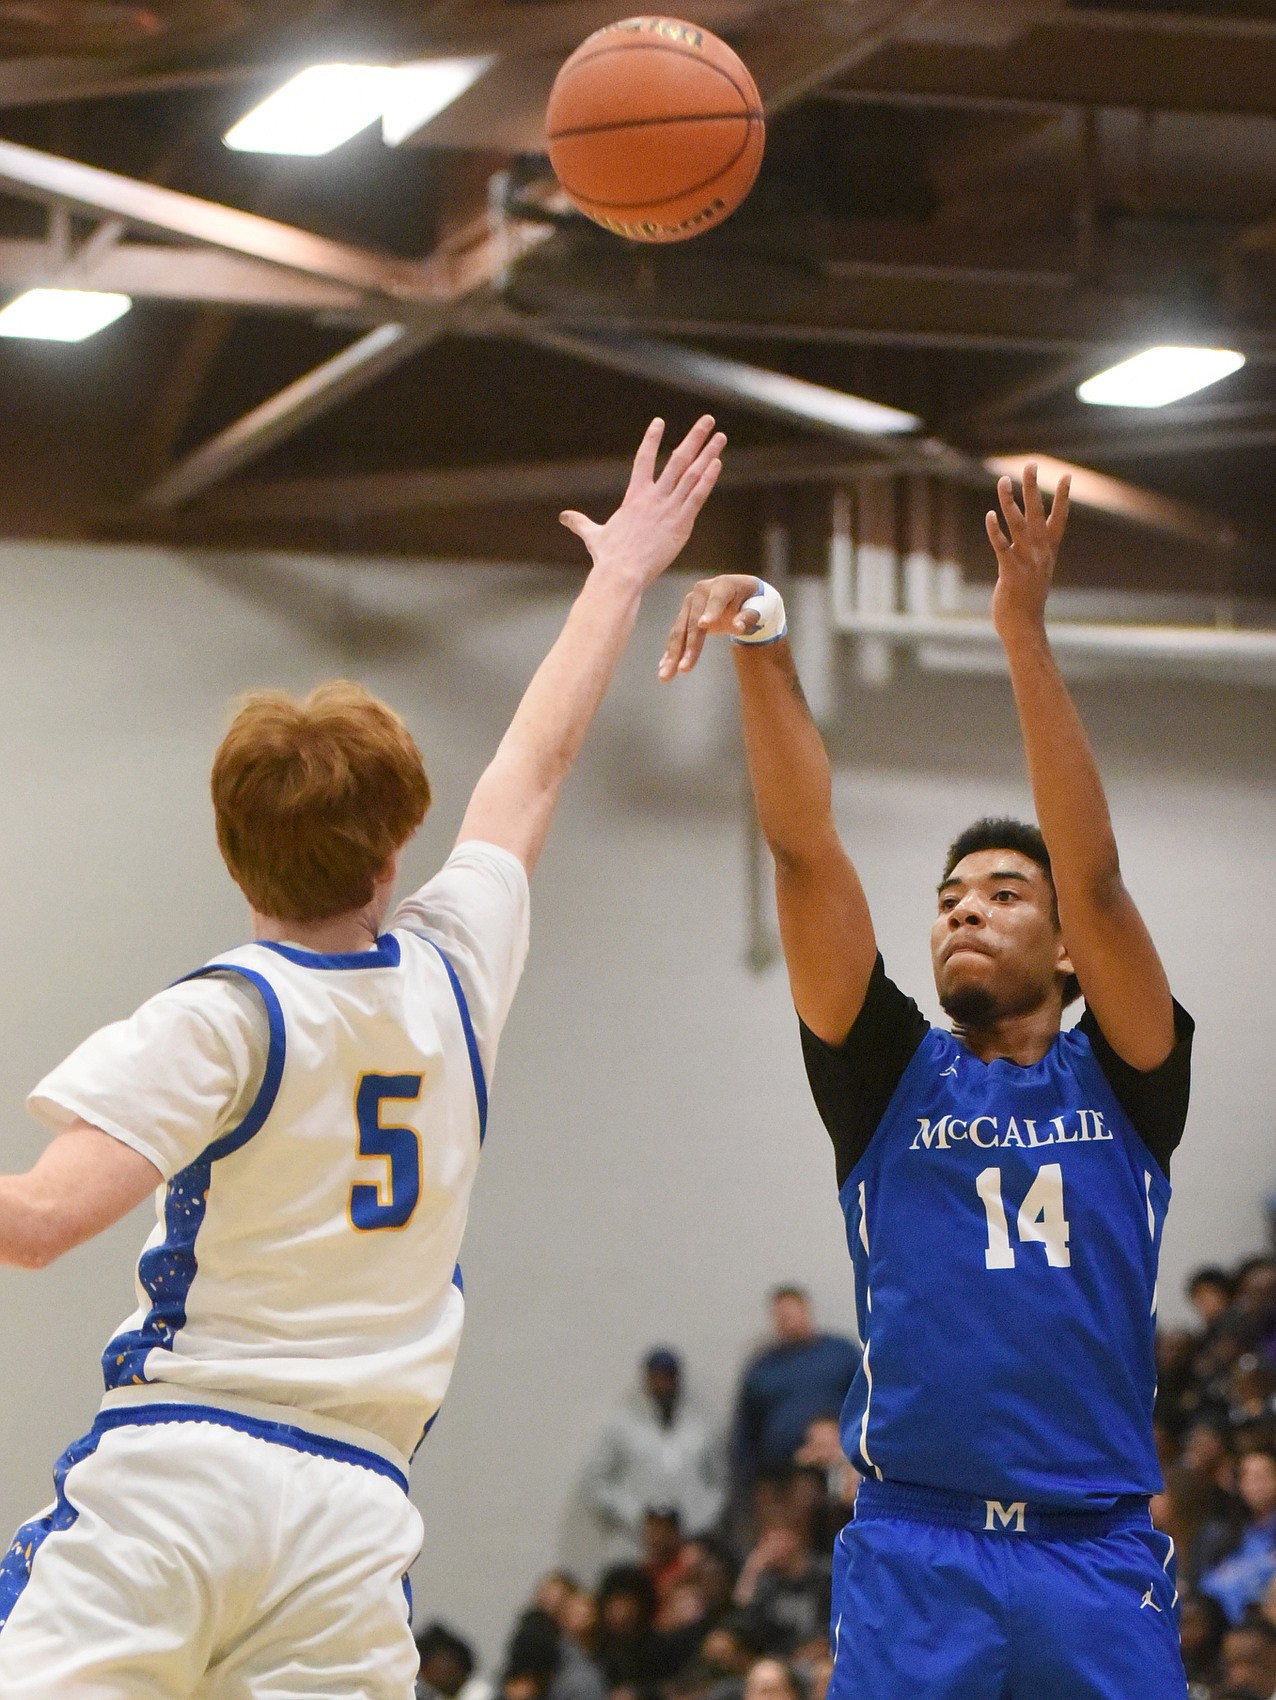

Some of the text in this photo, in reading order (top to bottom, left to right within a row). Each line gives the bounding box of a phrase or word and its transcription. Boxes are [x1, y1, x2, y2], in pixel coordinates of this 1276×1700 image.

[346, 1070, 425, 1233] 5
[975, 1163, 1071, 1270] 14
[982, 1500, 1028, 1532] M
